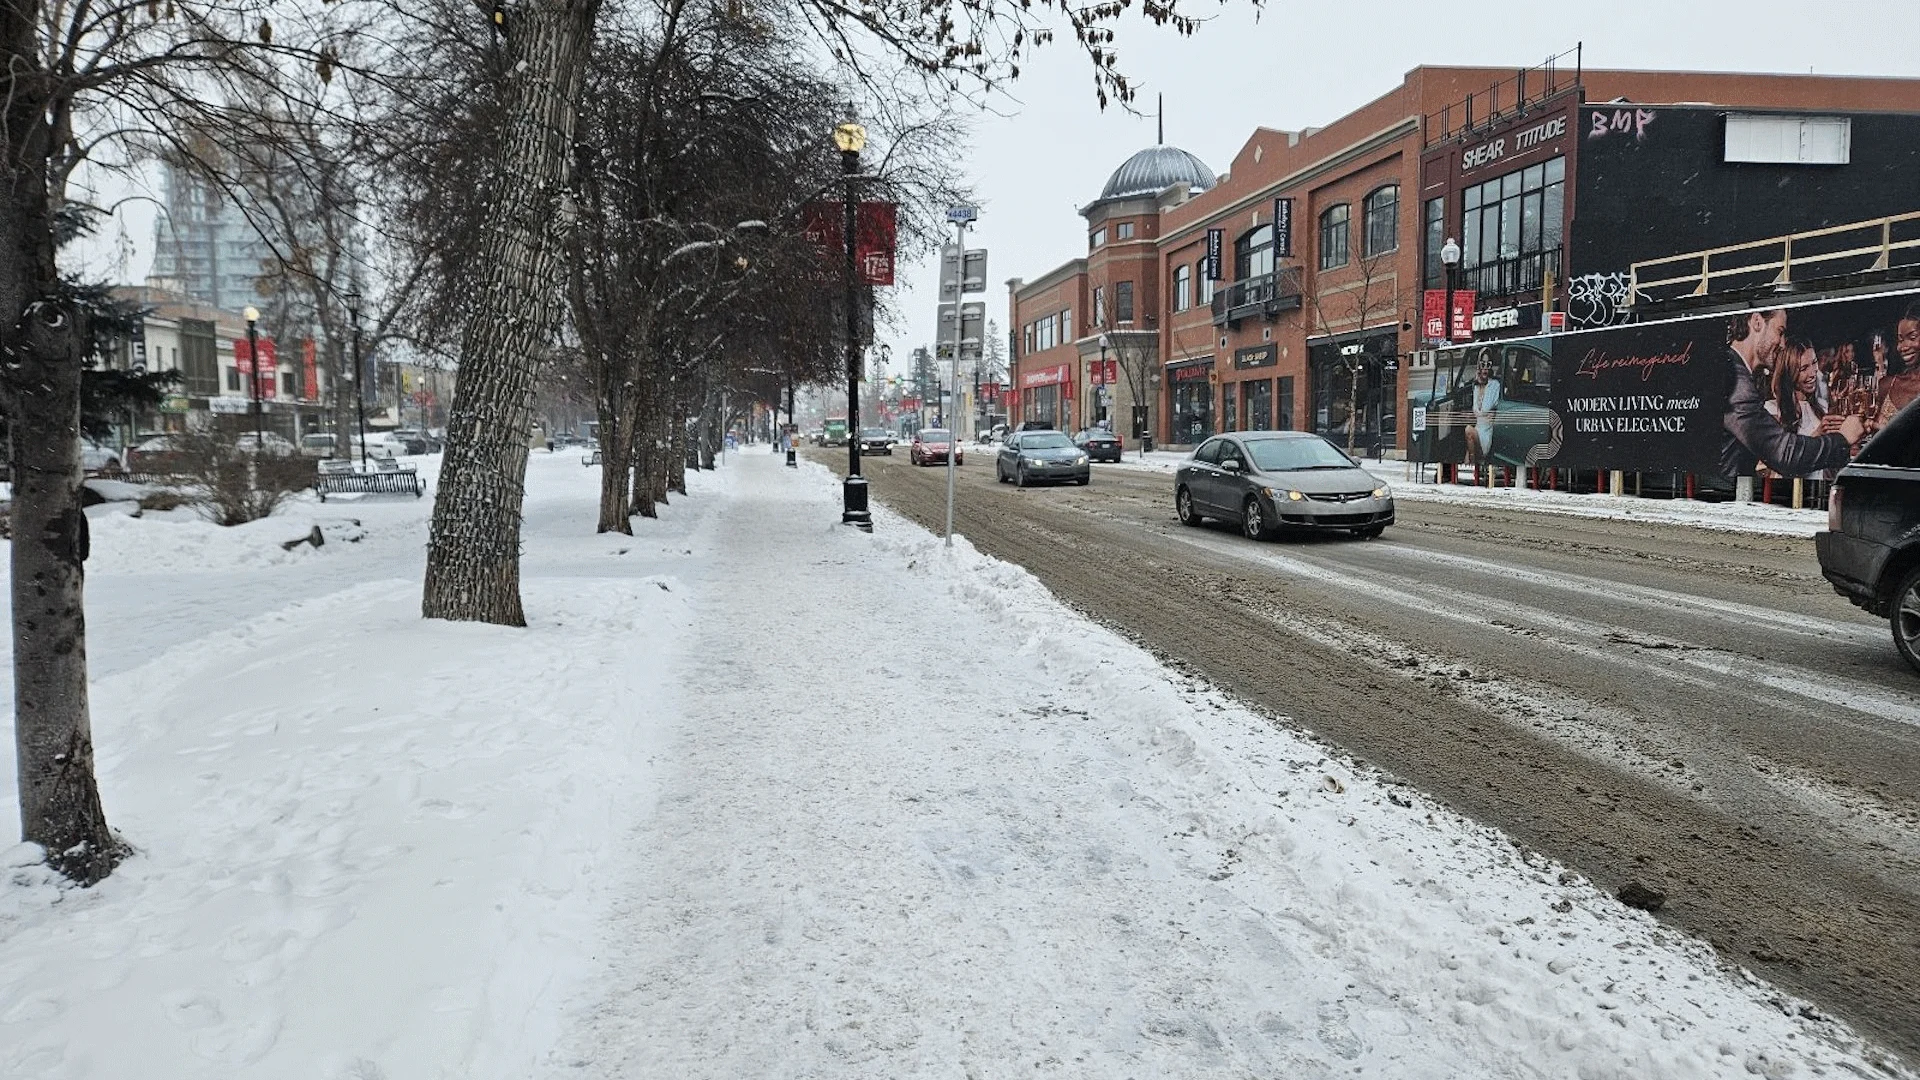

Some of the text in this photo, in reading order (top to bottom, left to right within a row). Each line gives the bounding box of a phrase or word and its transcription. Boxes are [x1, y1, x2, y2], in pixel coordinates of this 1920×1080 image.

[1462, 138, 1505, 170] SHEAR
[1472, 308, 1519, 332] URGER
[1575, 340, 1691, 381] Life reimagined
[1566, 395, 1700, 412] MODERN LIVING meets
[1575, 416, 1686, 432] URBAN ELEGANCE
